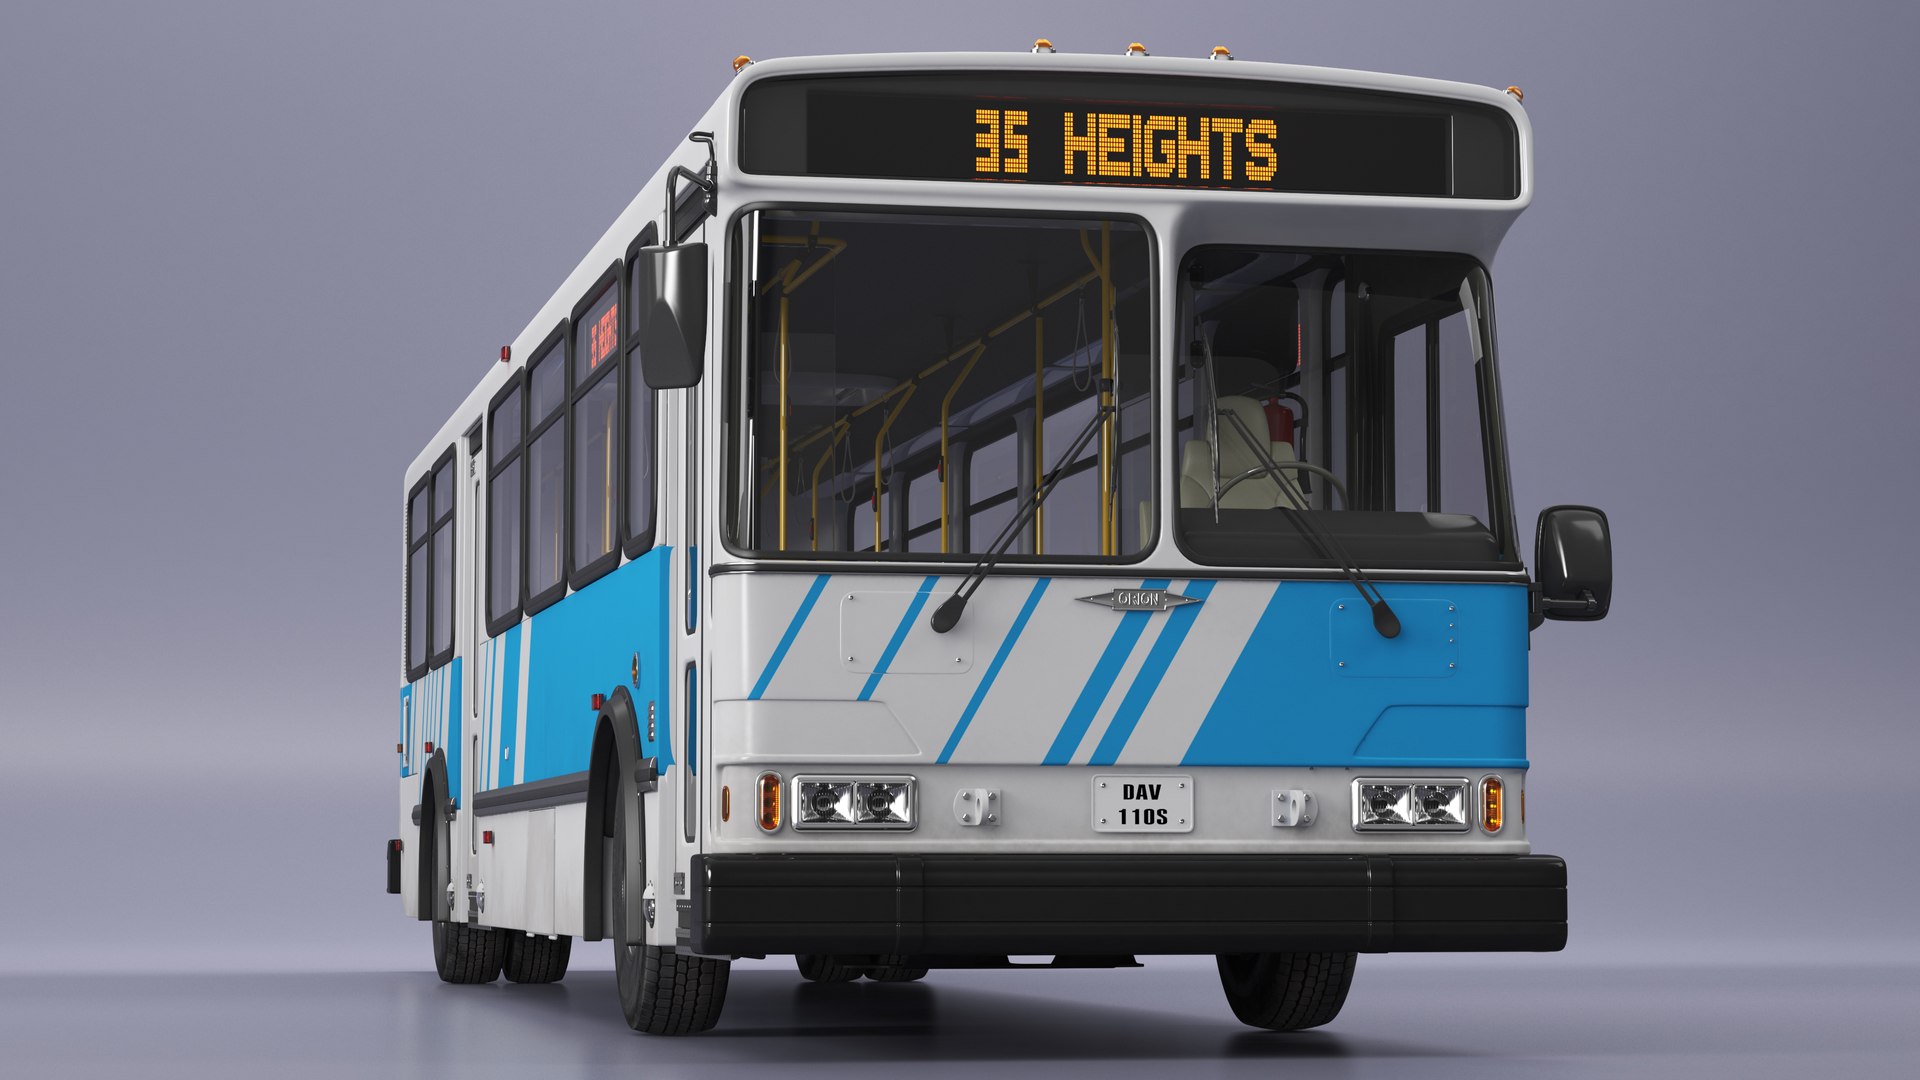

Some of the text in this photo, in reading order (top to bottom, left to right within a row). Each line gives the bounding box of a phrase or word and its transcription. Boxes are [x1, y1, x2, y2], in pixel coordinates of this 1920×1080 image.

[976, 109, 1277, 181] 35 HEIGHTS
[1118, 592, 1158, 605] ORION
[1123, 784, 1161, 800] DAV
[1118, 808, 1168, 825] 110S
